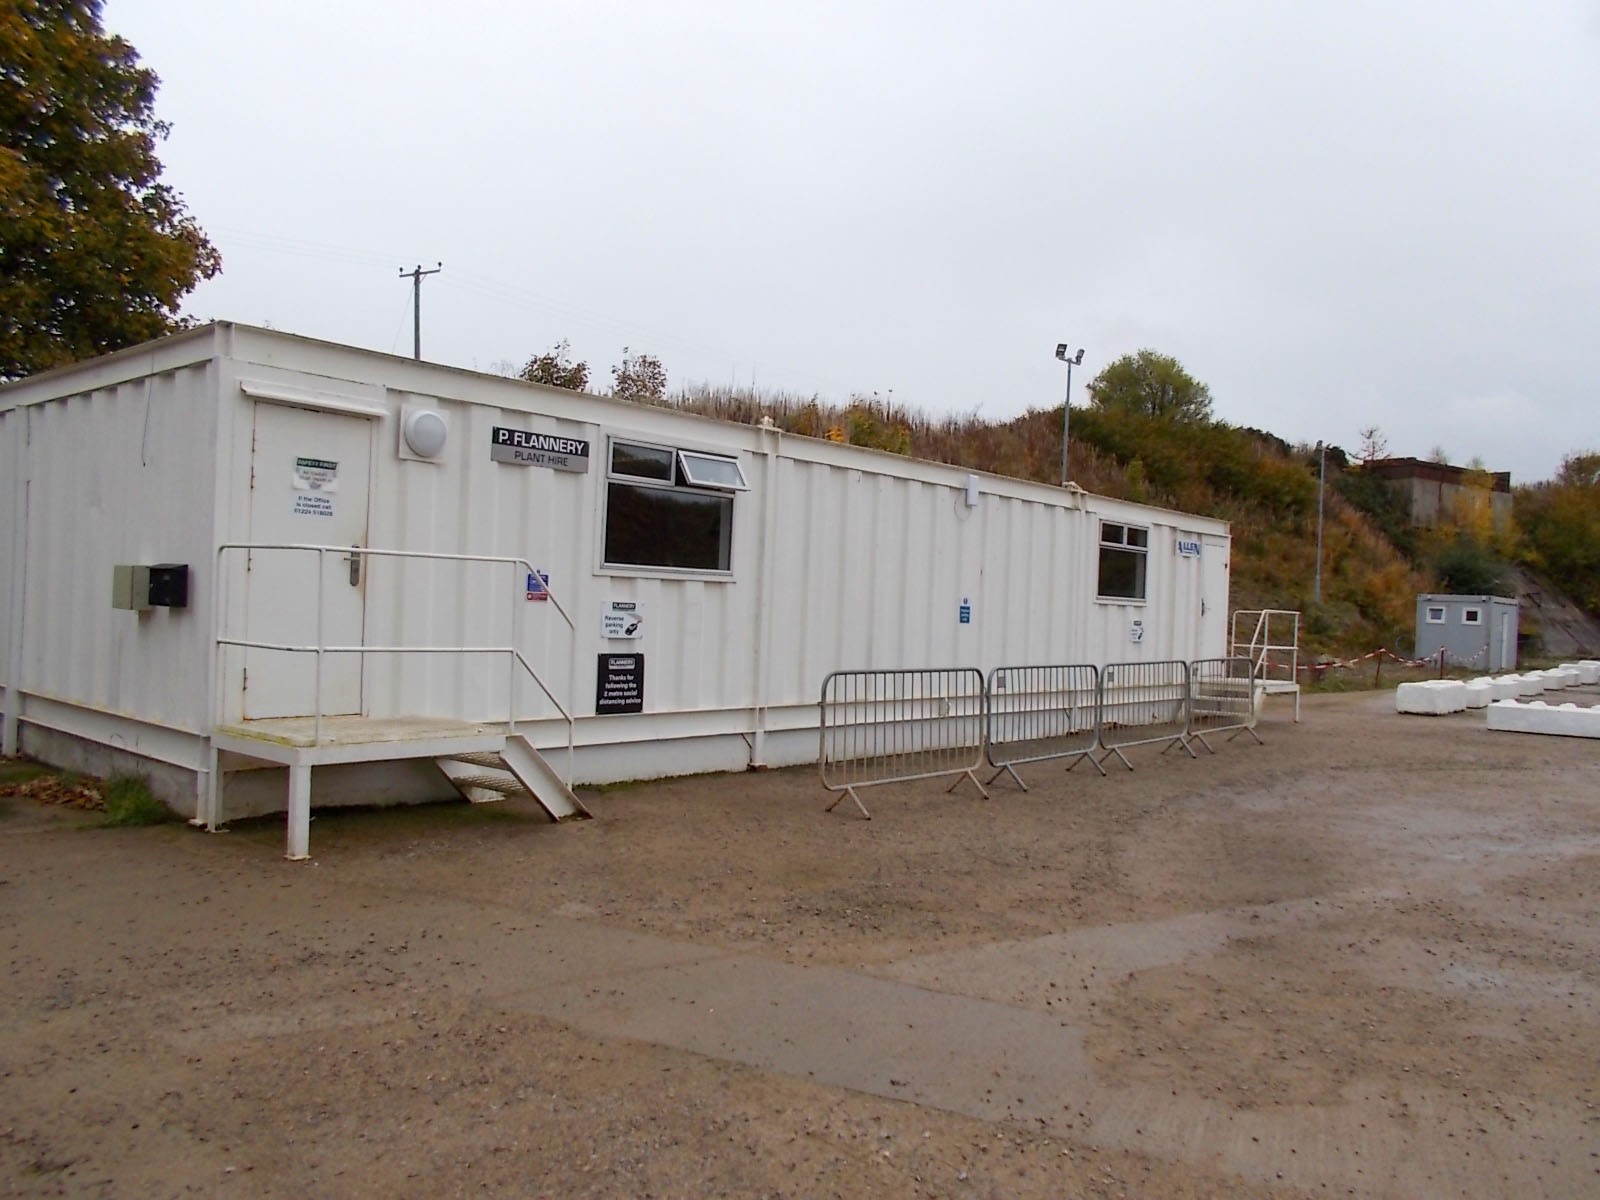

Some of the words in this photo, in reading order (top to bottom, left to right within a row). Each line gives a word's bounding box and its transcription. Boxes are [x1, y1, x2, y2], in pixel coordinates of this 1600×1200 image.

[499, 429, 511, 444] P.
[514, 432, 584, 454] FLANNERY
[514, 450, 545, 463] PLANT
[548, 456, 568, 467] HIRE
[605, 682, 628, 690] following
